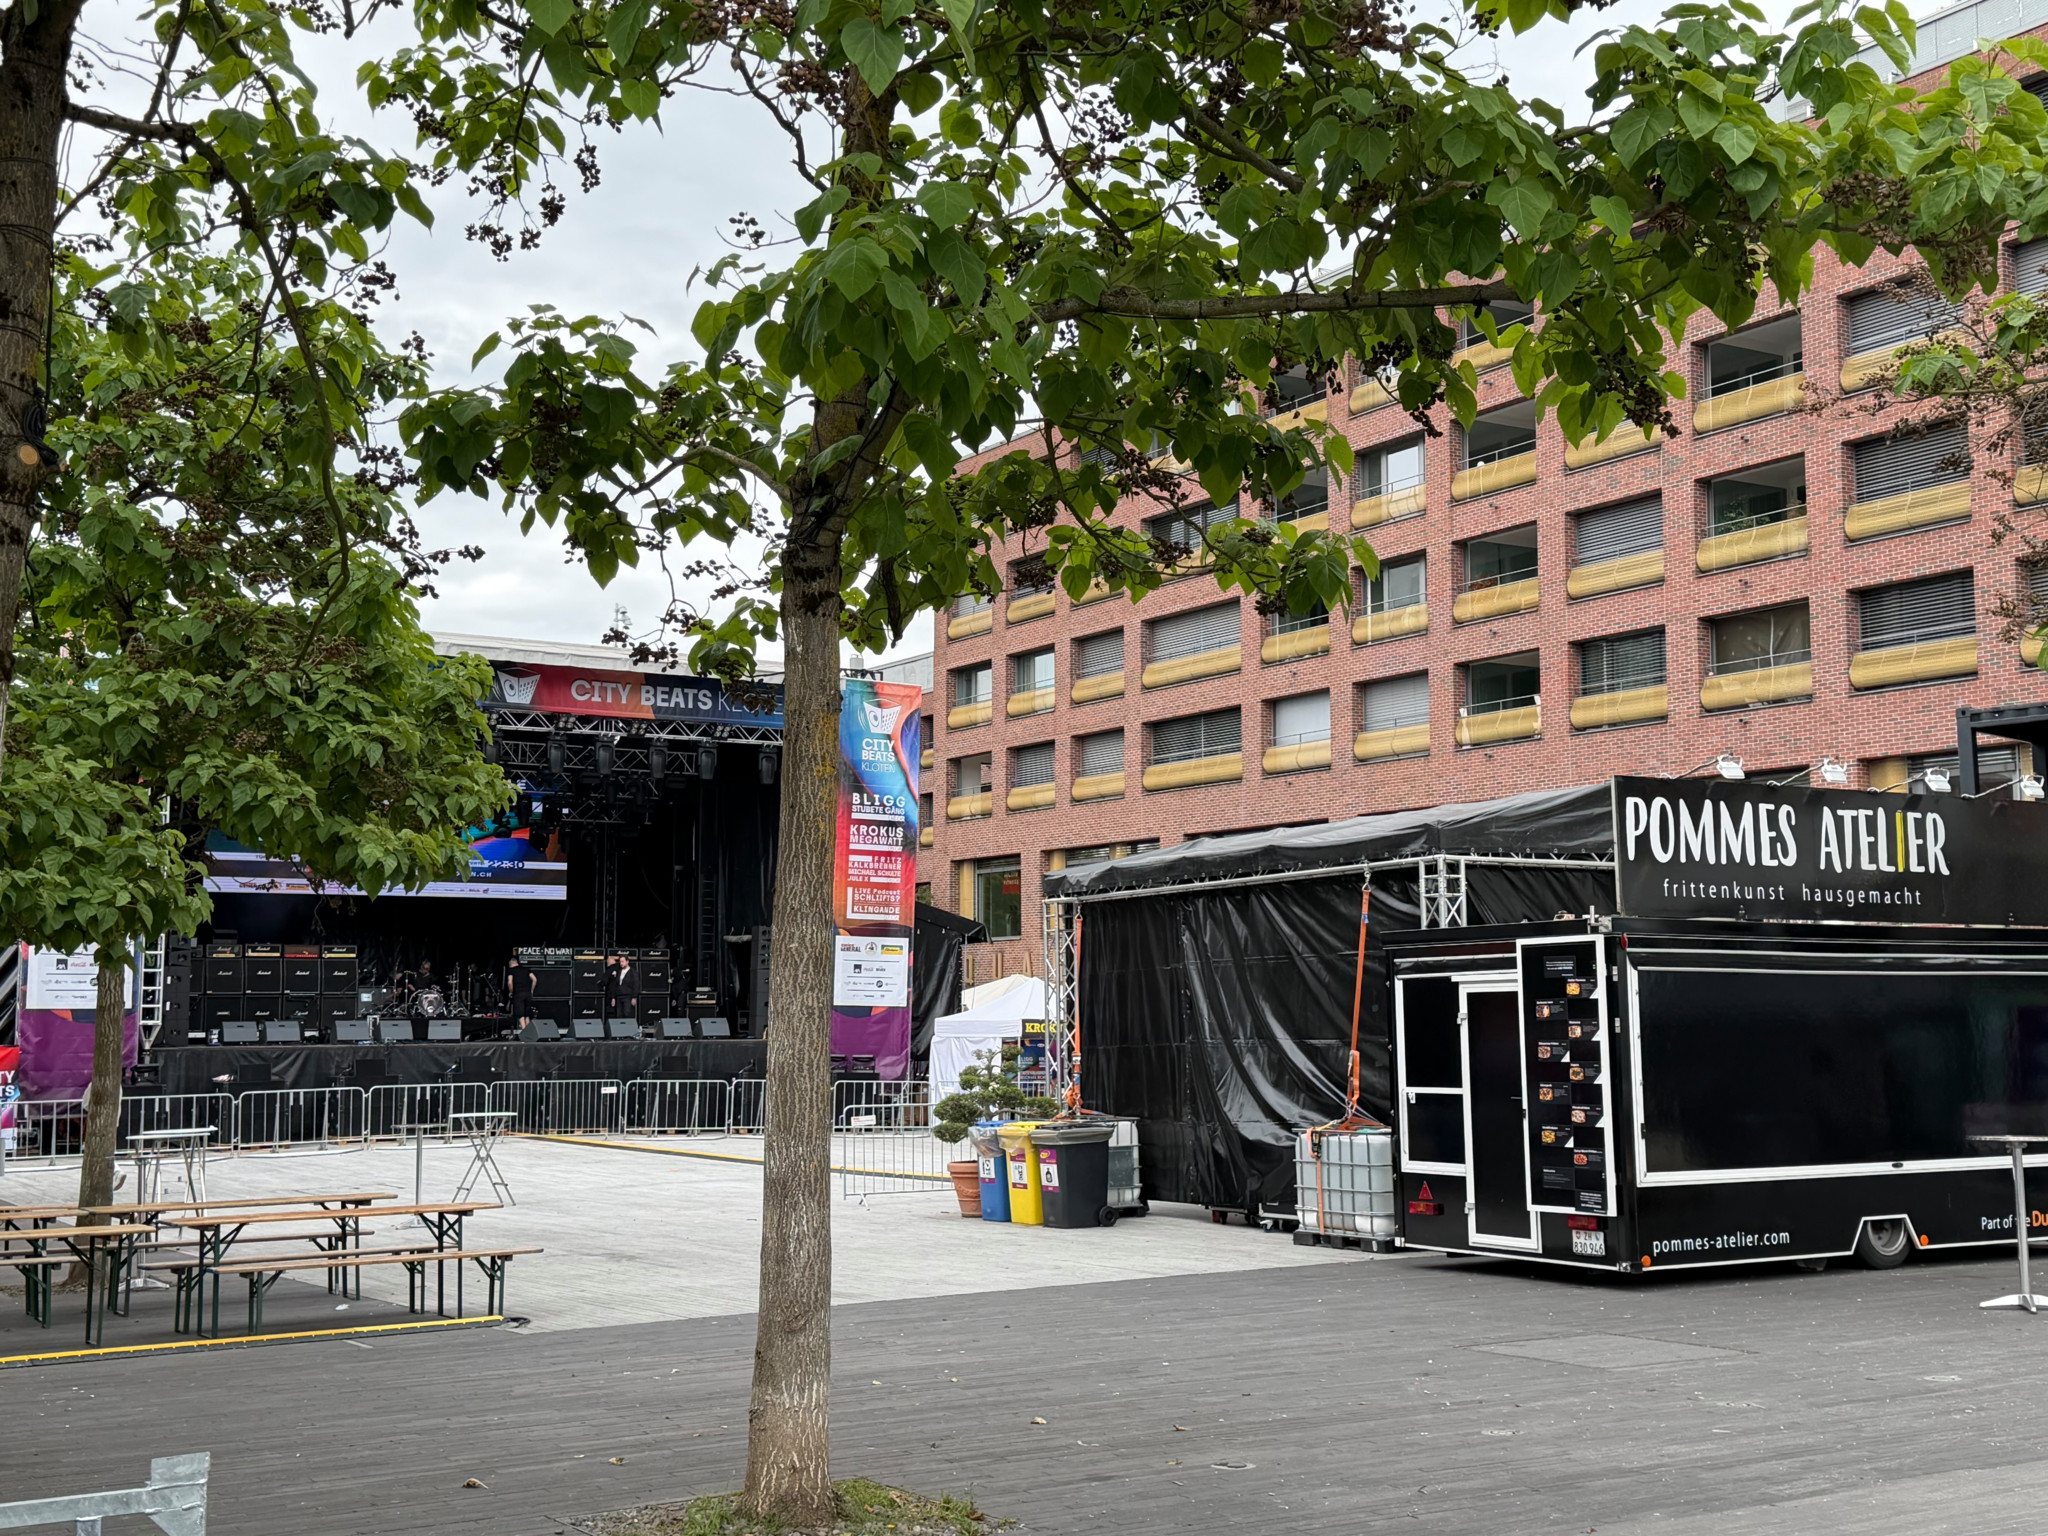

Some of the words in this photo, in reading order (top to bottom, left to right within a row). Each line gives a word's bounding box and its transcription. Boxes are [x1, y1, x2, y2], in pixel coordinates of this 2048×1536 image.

[571, 679, 632, 704] CITY
[640, 685, 713, 710] BEATS
[862, 738, 895, 751] CITY
[861, 750, 896, 762] BEATS
[861, 762, 896, 773] KLOTEN
[852, 793, 906, 808] BLIGG
[851, 805, 883, 814] STUBETE
[850, 825, 904, 838] KROKUS
[1626, 797, 1798, 867] POMMES
[1820, 806, 1950, 876] ATELIER
[849, 835, 904, 846] MEGAWATT
[874, 856, 902, 864] FRITZ
[1664, 879, 1785, 901] frittenkunst
[1802, 884, 1922, 907] hausgemacht
[853, 906, 900, 914] KLINGANDE
[518, 947, 541, 955] PEACE
[1981, 1217, 2001, 1230] Part
[2002, 1214, 2013, 1229] of
[1574, 1241, 1588, 1253] 830
[1589, 1242, 1604, 1255] 946
[1653, 1231, 1790, 1257] pommes-atelier.com
